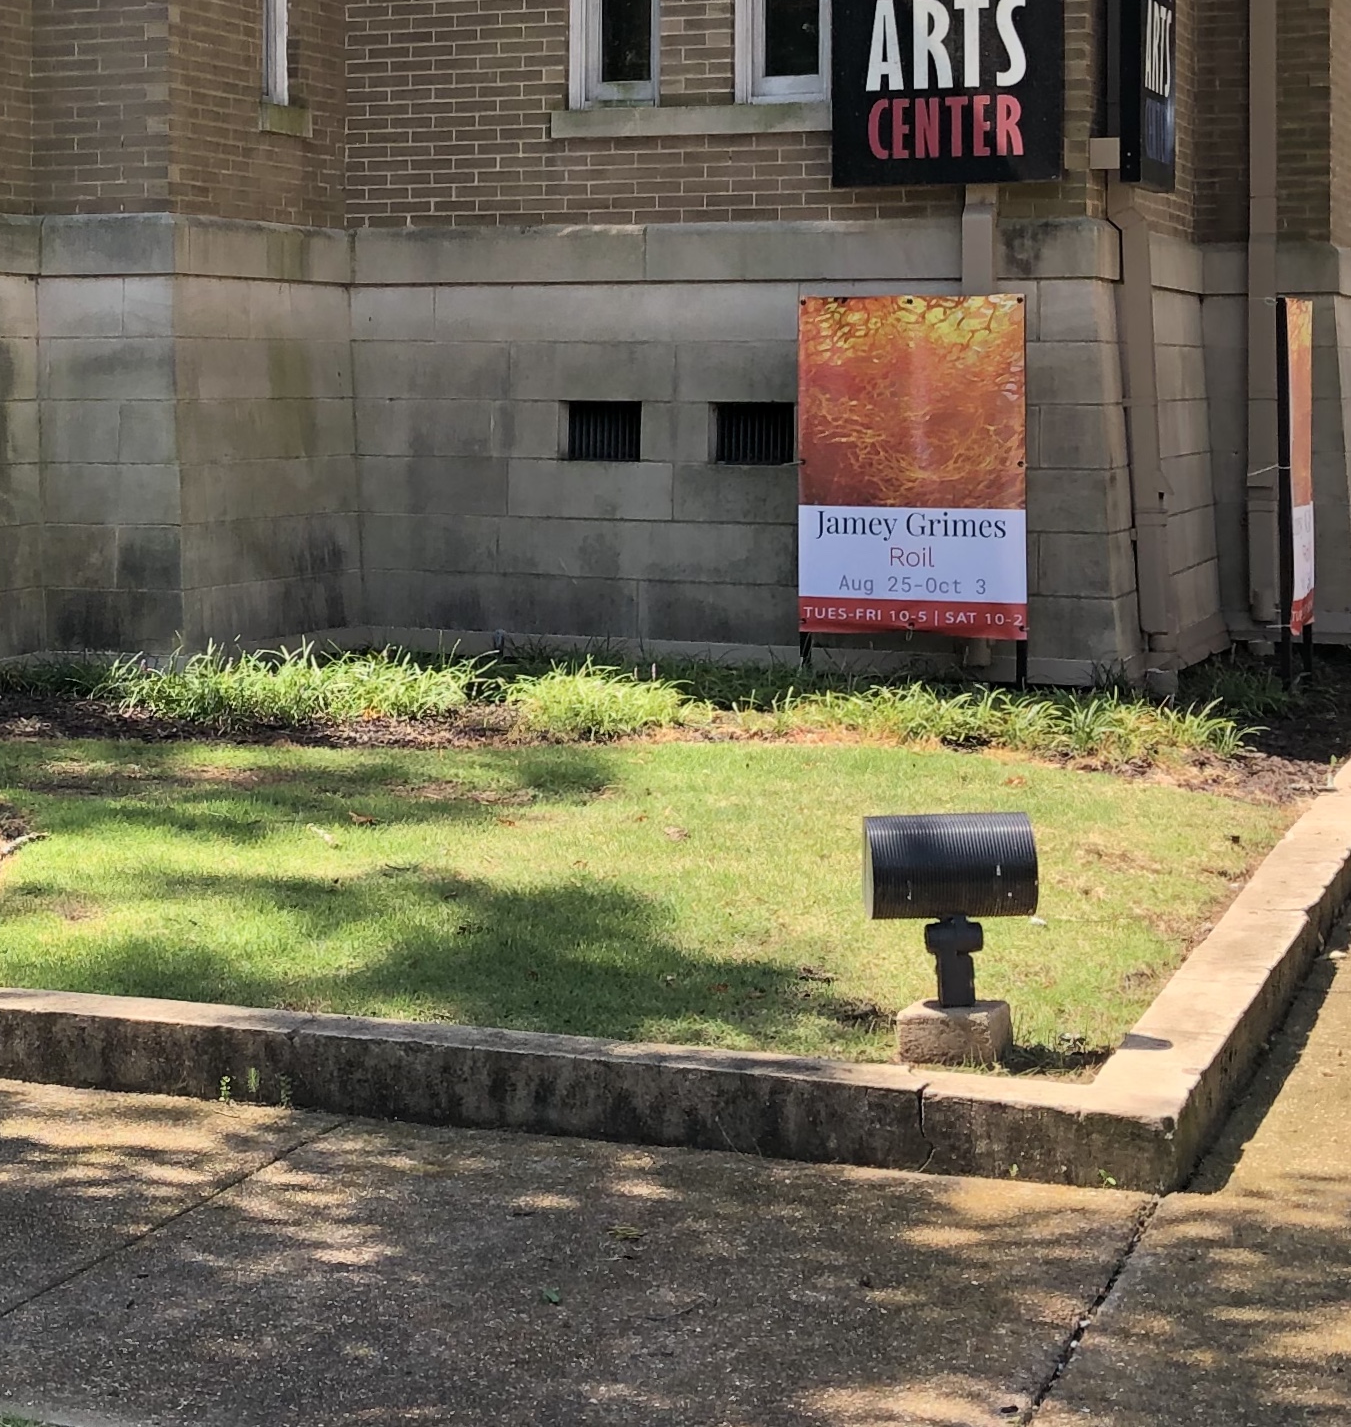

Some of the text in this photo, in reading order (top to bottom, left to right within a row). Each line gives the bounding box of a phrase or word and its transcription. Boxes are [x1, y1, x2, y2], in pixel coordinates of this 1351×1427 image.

[868, 94, 1024, 159] CENTER
[816, 511, 1006, 541] Jamey Grimes
[890, 546, 935, 567] Roil
[839, 574, 874, 595] Aug
[976, 579, 986, 594] 3
[803, 606, 1023, 626] TUES-FRI 10-5 SAT 10-2
